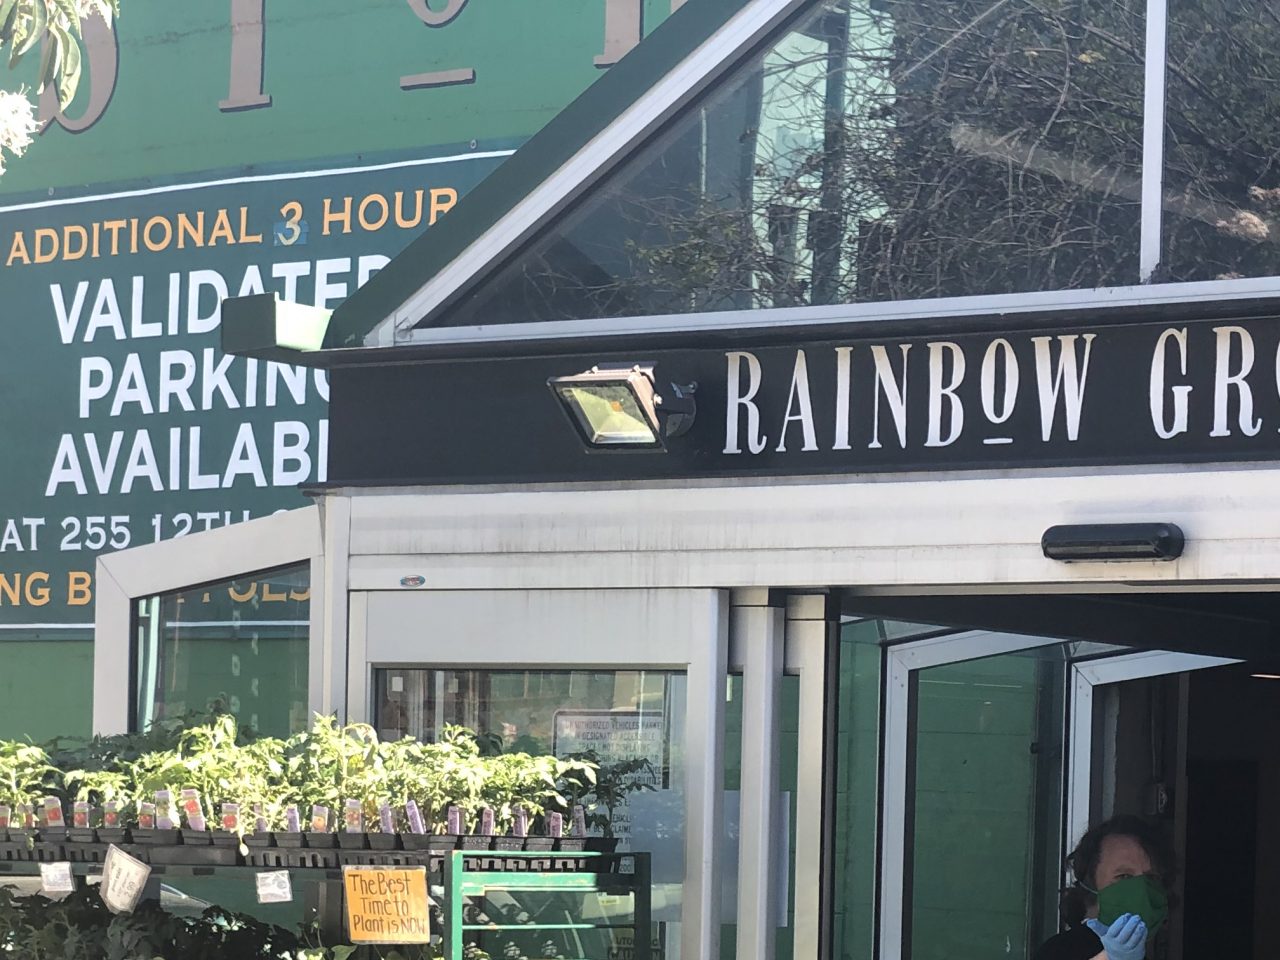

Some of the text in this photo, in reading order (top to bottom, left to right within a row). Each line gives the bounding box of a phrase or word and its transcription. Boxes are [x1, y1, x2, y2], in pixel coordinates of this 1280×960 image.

[6, 206, 263, 266] ADDITIONAL
[279, 202, 303, 246] 3
[722, 332, 1097, 455] RAINBOW
[0, 517, 46, 551] AT
[60, 515, 131, 551] 255
[348, 872, 411, 896] The Best
[360, 895, 409, 916] Time to
[353, 914, 425, 934] Plant is NOW
